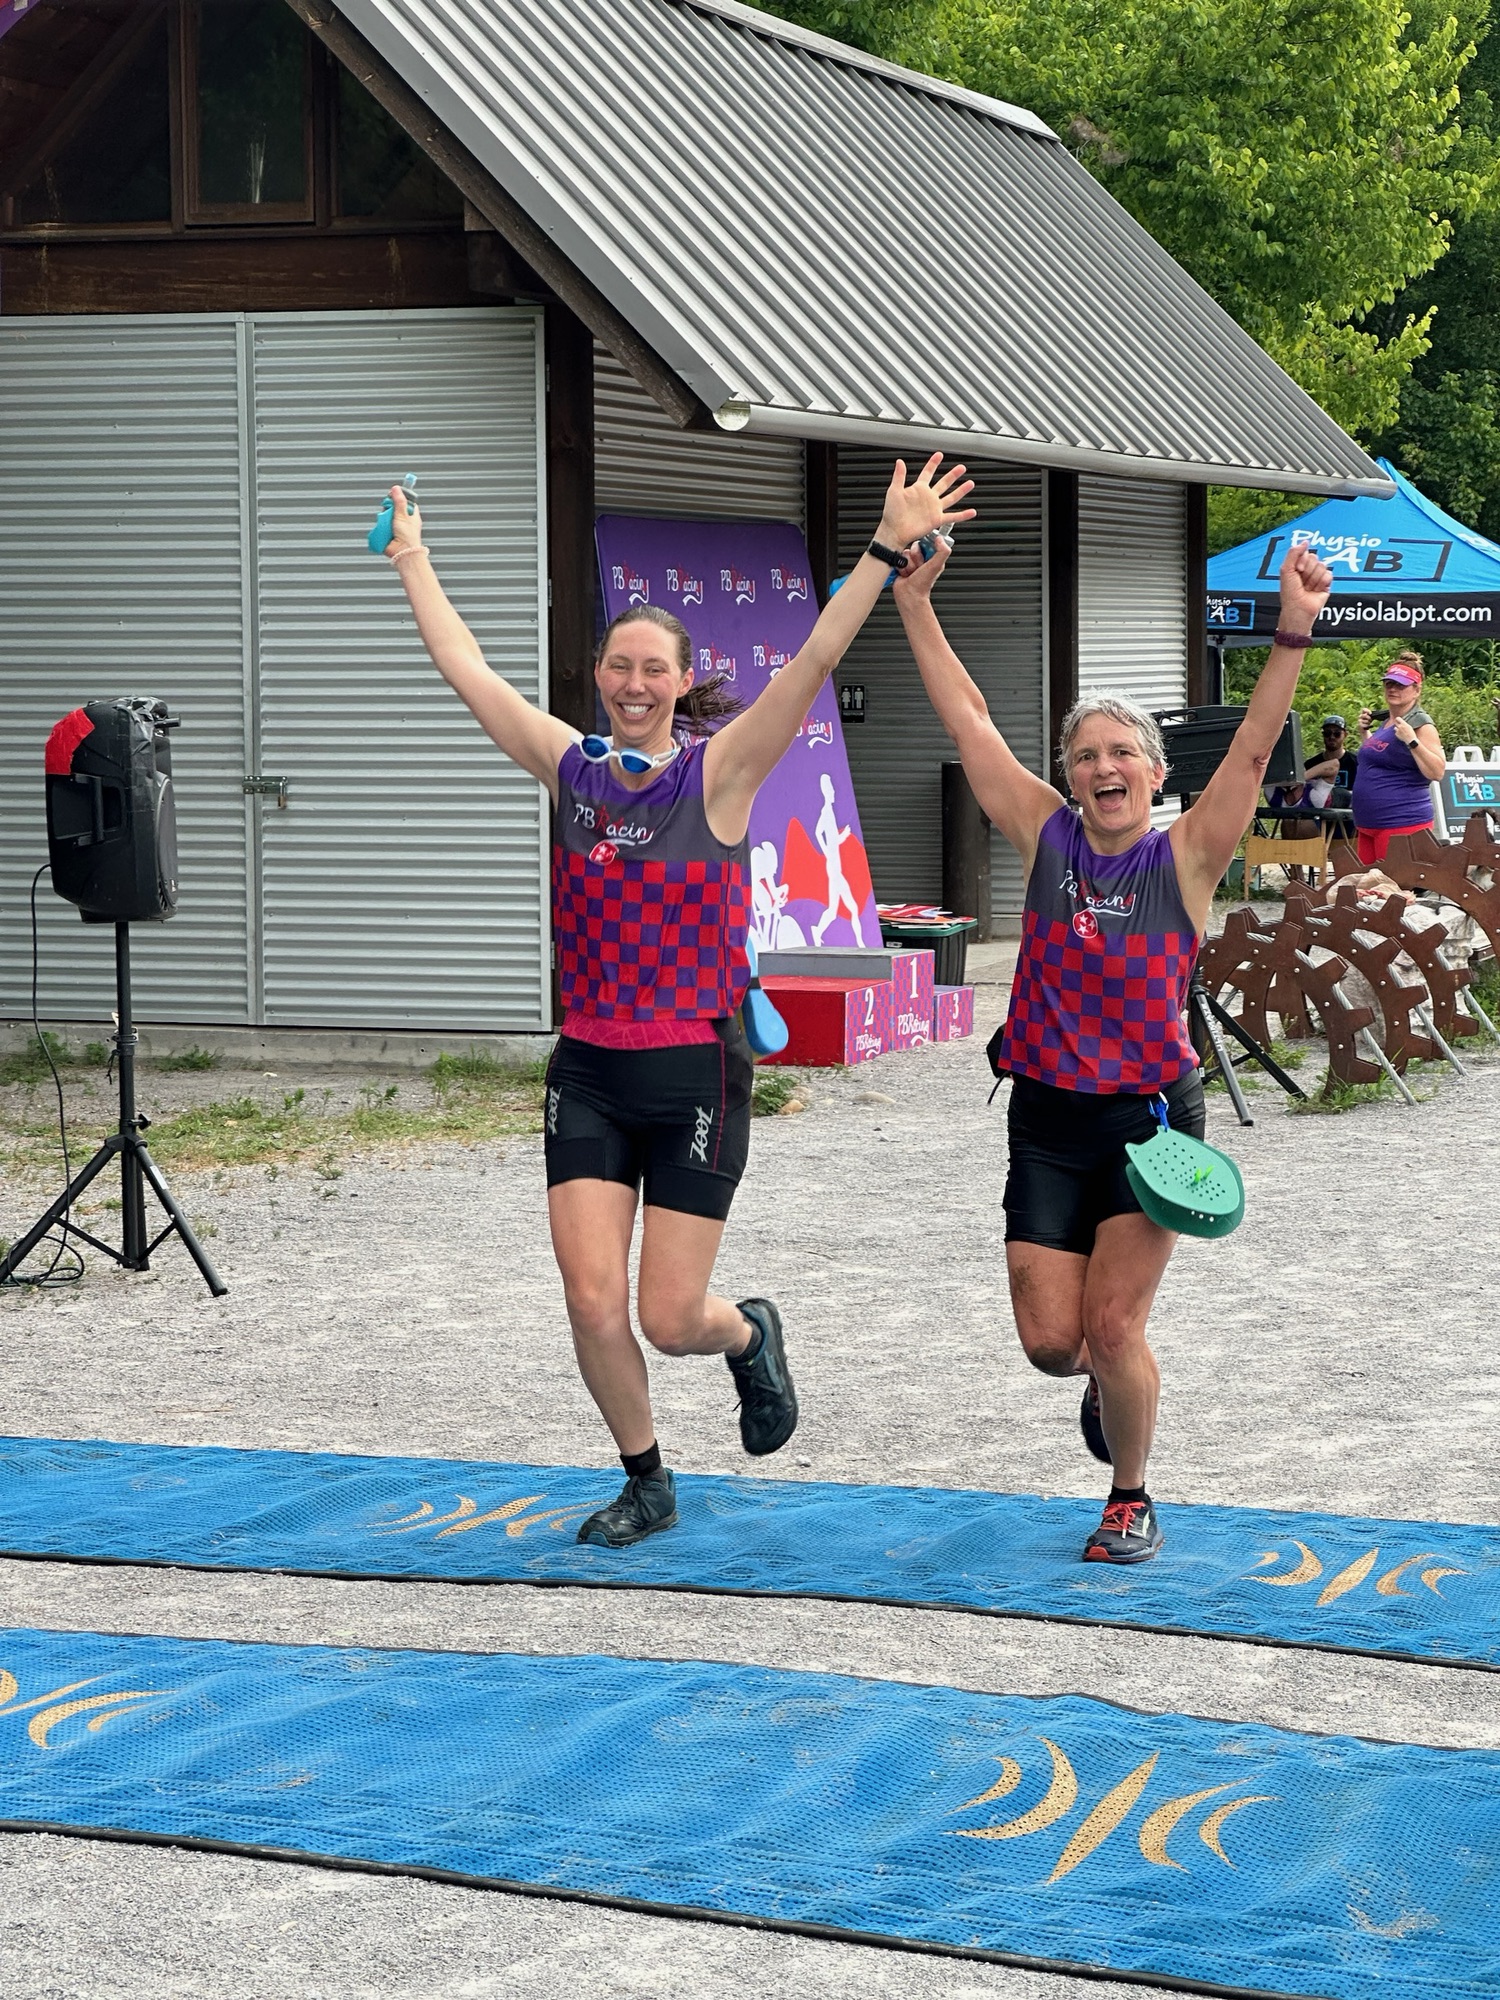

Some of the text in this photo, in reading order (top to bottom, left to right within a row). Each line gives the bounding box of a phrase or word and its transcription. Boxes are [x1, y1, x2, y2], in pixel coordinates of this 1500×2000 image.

[1290, 529, 1382, 552] Physio
[1307, 546, 1404, 573] AB
[612, 561, 649, 605] PBRacing
[666, 563, 703, 606] PBRacing
[720, 564, 756, 606] PBRacing
[770, 564, 808, 602] PBRacing
[1206, 595, 1232, 609] hysio
[1318, 600, 1492, 628] hysiolabpt.com
[1455, 772, 1485, 787] Physio
[1463, 783, 1496, 800] LAB
[909, 957, 919, 999] 1
[864, 988, 875, 1026] 2
[952, 992, 959, 1019] 3
